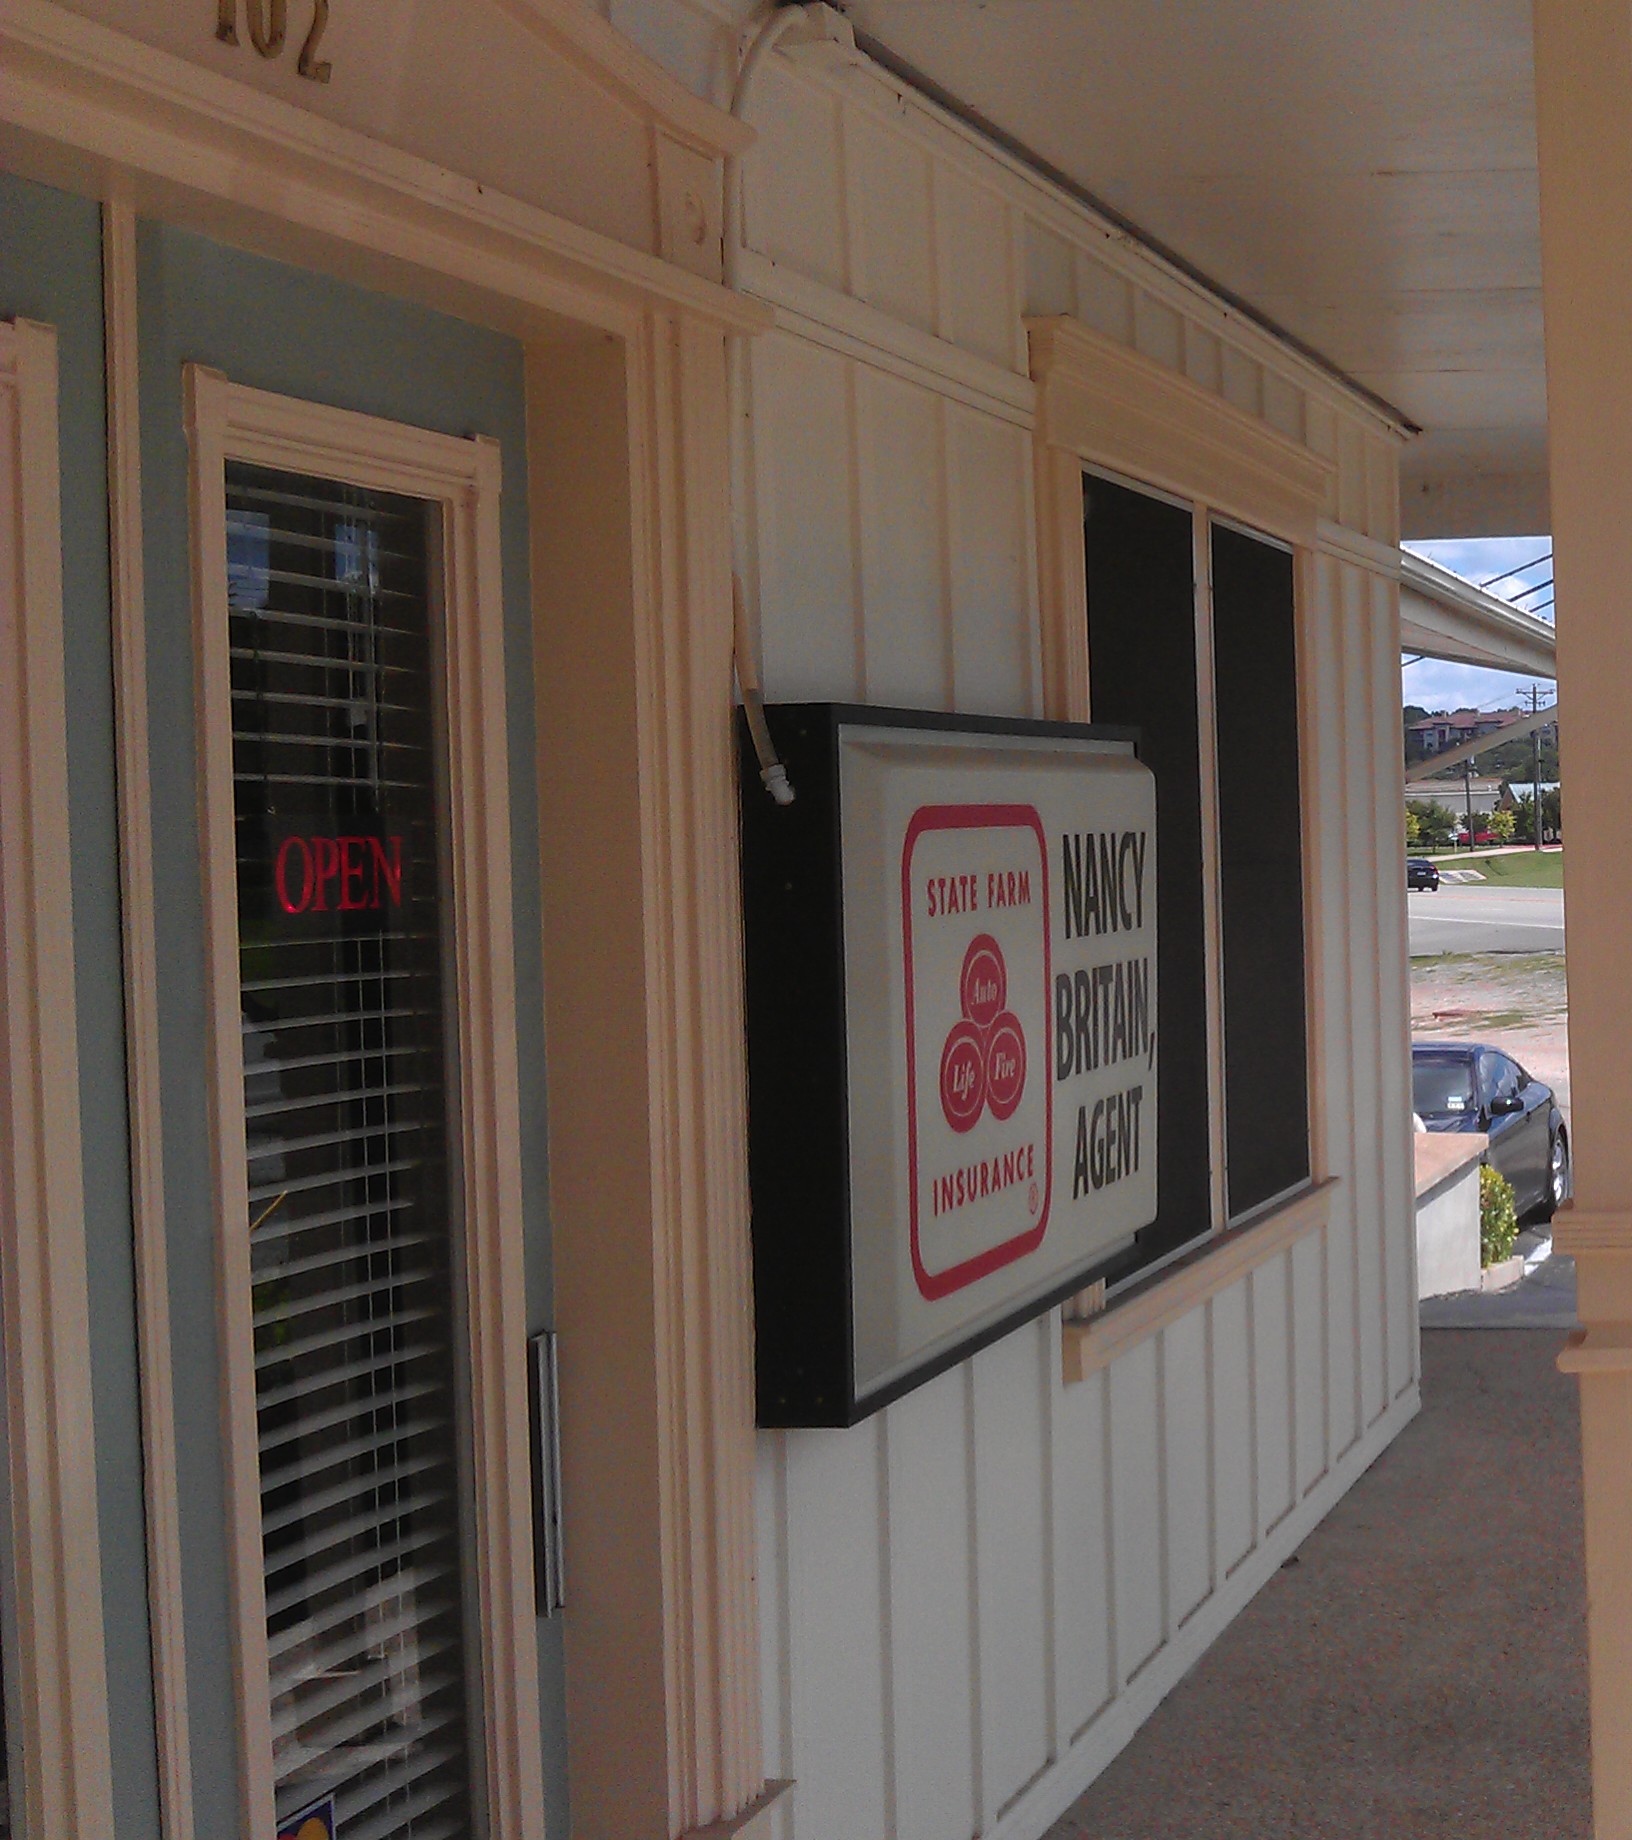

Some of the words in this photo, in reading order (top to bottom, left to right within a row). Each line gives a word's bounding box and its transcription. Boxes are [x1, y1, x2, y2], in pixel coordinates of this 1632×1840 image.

[274, 835, 405, 914] OPEN
[926, 874, 978, 917] STATE
[987, 870, 1032, 908] FARM
[1062, 831, 1146, 940] NANCY
[971, 976, 998, 1005] Auto
[1055, 957, 1155, 1082] BRITAIN,
[953, 1060, 976, 1101] Life
[994, 1051, 1017, 1081] Fire
[1073, 1085, 1143, 1200] AGENT
[932, 1144, 1035, 1217] INSURANCE
